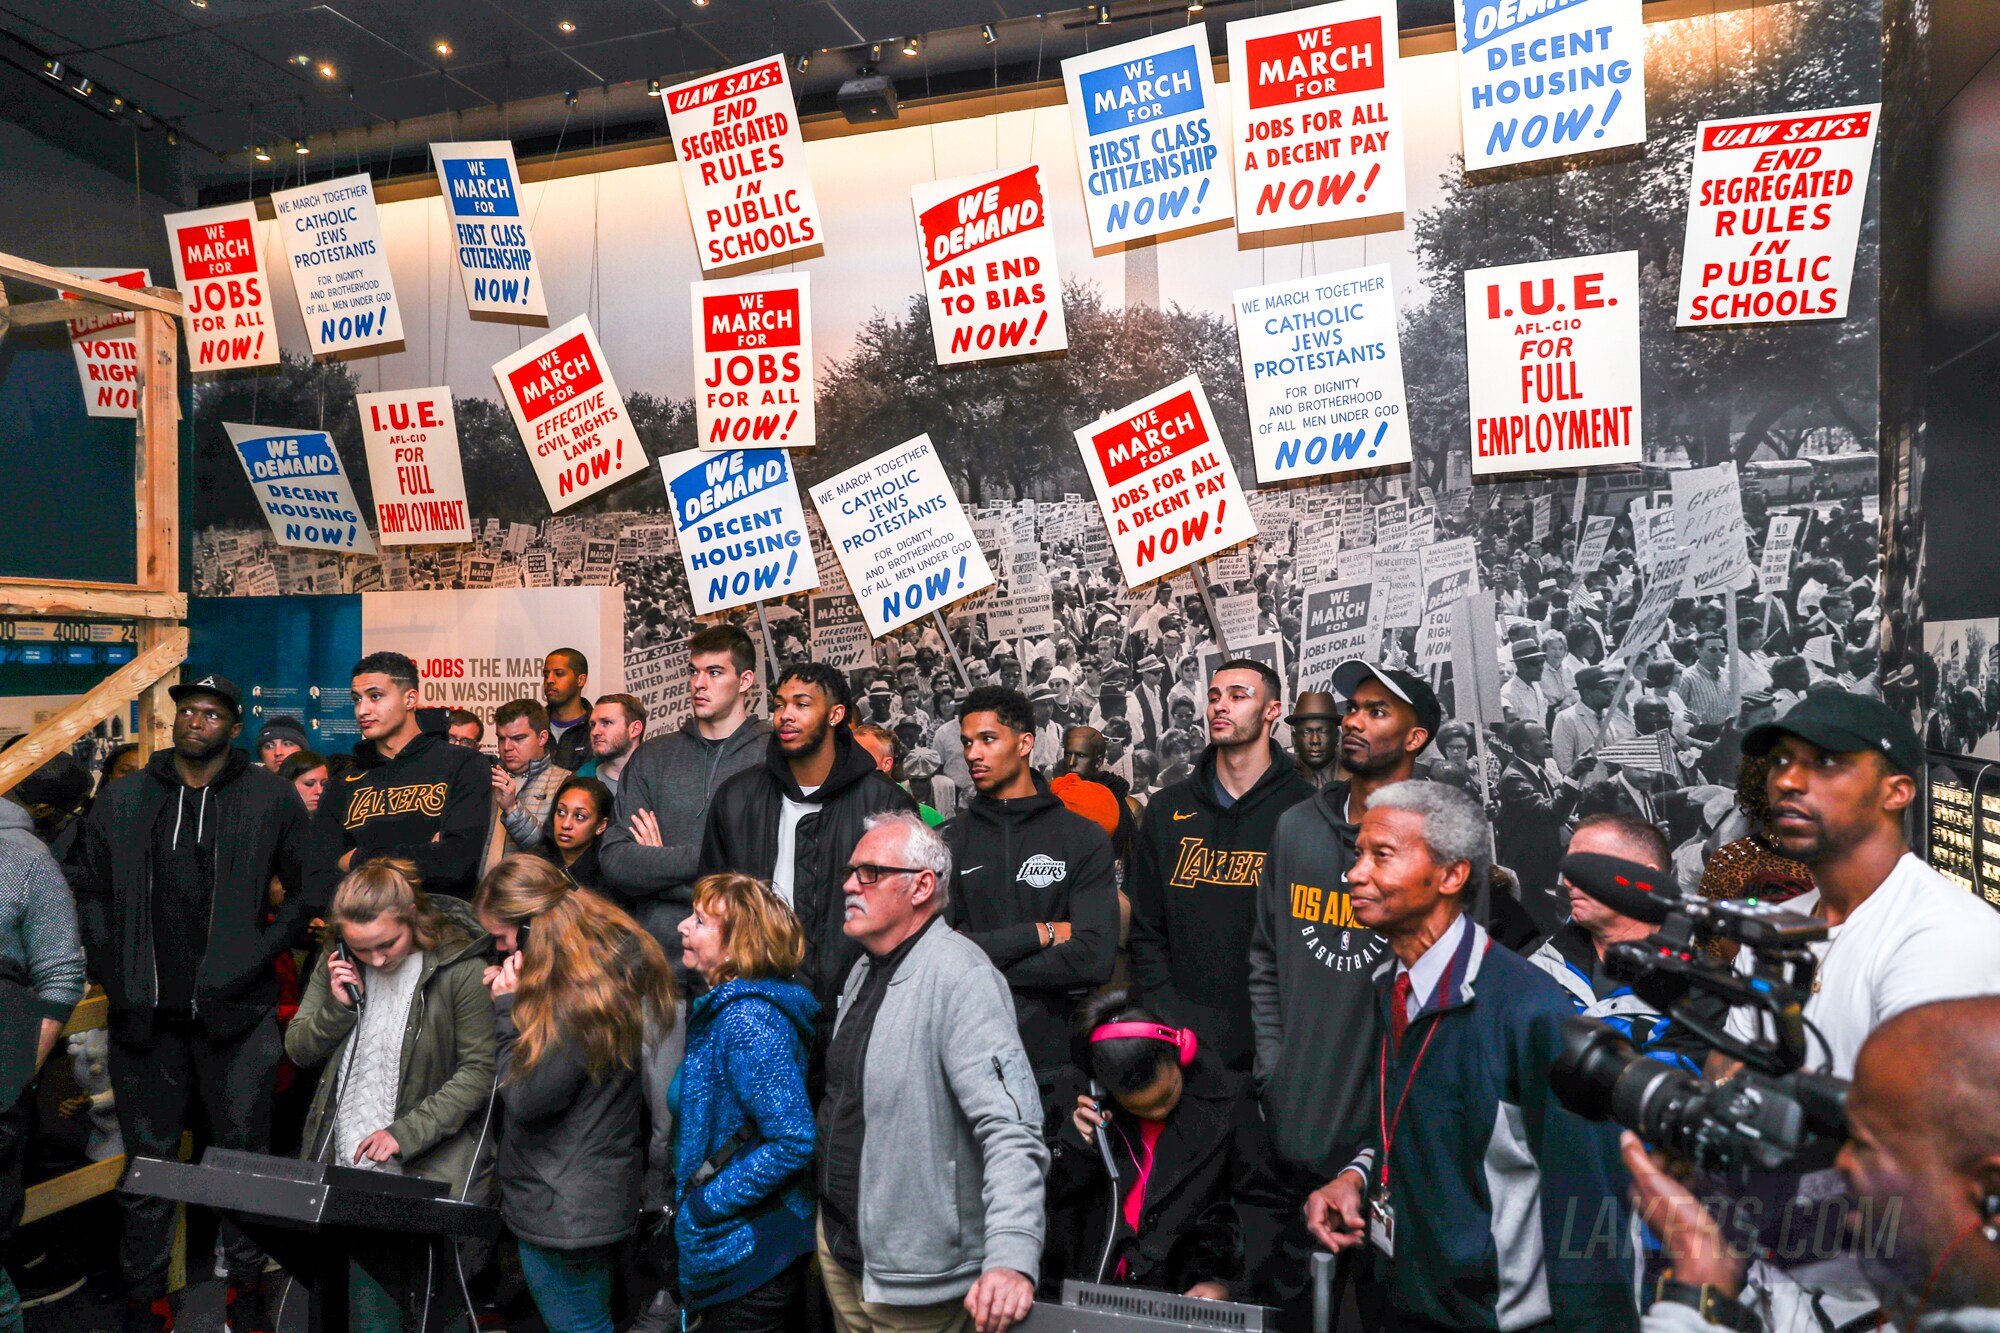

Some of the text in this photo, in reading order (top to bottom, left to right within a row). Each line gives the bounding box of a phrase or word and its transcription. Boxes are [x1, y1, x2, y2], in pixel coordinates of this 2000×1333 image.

[1297, 28, 1332, 51] WE
[1487, 26, 1613, 71] DECENT
[1259, 43, 1372, 86] MARCH
[1295, 78, 1336, 98] FOR
[1472, 60, 1632, 109] HOUSING
[1245, 102, 1388, 143] JOBS FOR ALL
[1486, 89, 1622, 156] NOW!
[1712, 117, 1868, 147] UAW SAYS:
[1245, 131, 1389, 171] A DECENT PAY
[1753, 147, 1822, 173] END
[1256, 163, 1381, 216] NOW!
[1700, 169, 1853, 206] SEGREGATED
[958, 186, 1000, 224] WE
[205, 225, 225, 240] WE
[934, 199, 1038, 261] DEMAND
[1715, 203, 1832, 237] RULES
[188, 238, 249, 263] MARCH
[1749, 239, 1790, 256] IN
[209, 262, 232, 274] FOR
[938, 256, 1040, 290] AN END
[1702, 255, 1832, 288] PUBLIC
[189, 278, 261, 314] JOBS
[941, 283, 1045, 316] TO BIAS
[1241, 277, 1384, 314] WE MARCH TOGETHER
[1487, 272, 1618, 319] I.U.E.
[1689, 288, 1837, 321] SCHOOLS
[193, 311, 264, 333] FOR ALL
[951, 310, 1048, 354] NOW!
[1265, 303, 1364, 335] CATHOLIC
[1514, 318, 1581, 336] AFL-CIO
[200, 331, 264, 365] NOW!
[1291, 328, 1342, 352] JEWS
[1520, 337, 1573, 360] FOR
[87, 364, 136, 381] RIGH
[537, 351, 561, 371] WE
[1254, 342, 1385, 379] PROTESTANTS
[522, 352, 590, 405] MARCH
[1286, 378, 1360, 399] FOR DIGNITY
[1521, 361, 1583, 404] FULL
[98, 386, 136, 409] NO
[549, 385, 575, 405] FOR
[1269, 389, 1382, 417] AND BROTHERHOOD
[536, 391, 607, 440] EFFECTIVE
[1259, 404, 1399, 435] OF ALL MEN UNDER GOD
[537, 407, 618, 457] CIVIL RIGHTS
[1477, 406, 1632, 457] EMPLOYMENT
[266, 440, 299, 458] WE
[562, 433, 601, 461] LAWS
[1275, 420, 1388, 470] NOW!
[254, 454, 333, 478] DEMAND
[556, 437, 622, 497] NOW!
[267, 485, 339, 504] DECENT
[266, 502, 357, 523] HOUSING
[286, 524, 356, 547] NOW!
[831, 597, 847, 606] WE
[1330, 590, 1350, 604] WE
[817, 605, 860, 620] MARCH
[989, 604, 1050, 618] NATIONAL ASSOCIATION
[1311, 601, 1366, 627] MARCH
[1430, 612, 1451, 624] EQU
[53, 623, 91, 642] 4000
[813, 632, 868, 647] CIVIL RIGHTS
[819, 625, 864, 637] EFFECTIVE
[1326, 622, 1348, 632] FOR
[1427, 627, 1451, 639] RIGH
[828, 643, 853, 653] LAWS
[1303, 634, 1366, 660] JOBS FOR ALL
[421, 658, 545, 678] JOBS THE MAR
[625, 653, 690, 680] LET US RISE
[1301, 666, 1308, 678] A
[424, 682, 447, 701] ON
[626, 671, 679, 693] UNITED and
[641, 691, 658, 706] NE
[1016, 861, 1066, 881] LAKERS
[1170, 837, 1267, 887] LAKER
[1291, 883, 1322, 921] OS
[1301, 925, 1389, 972] BASKETBALL
